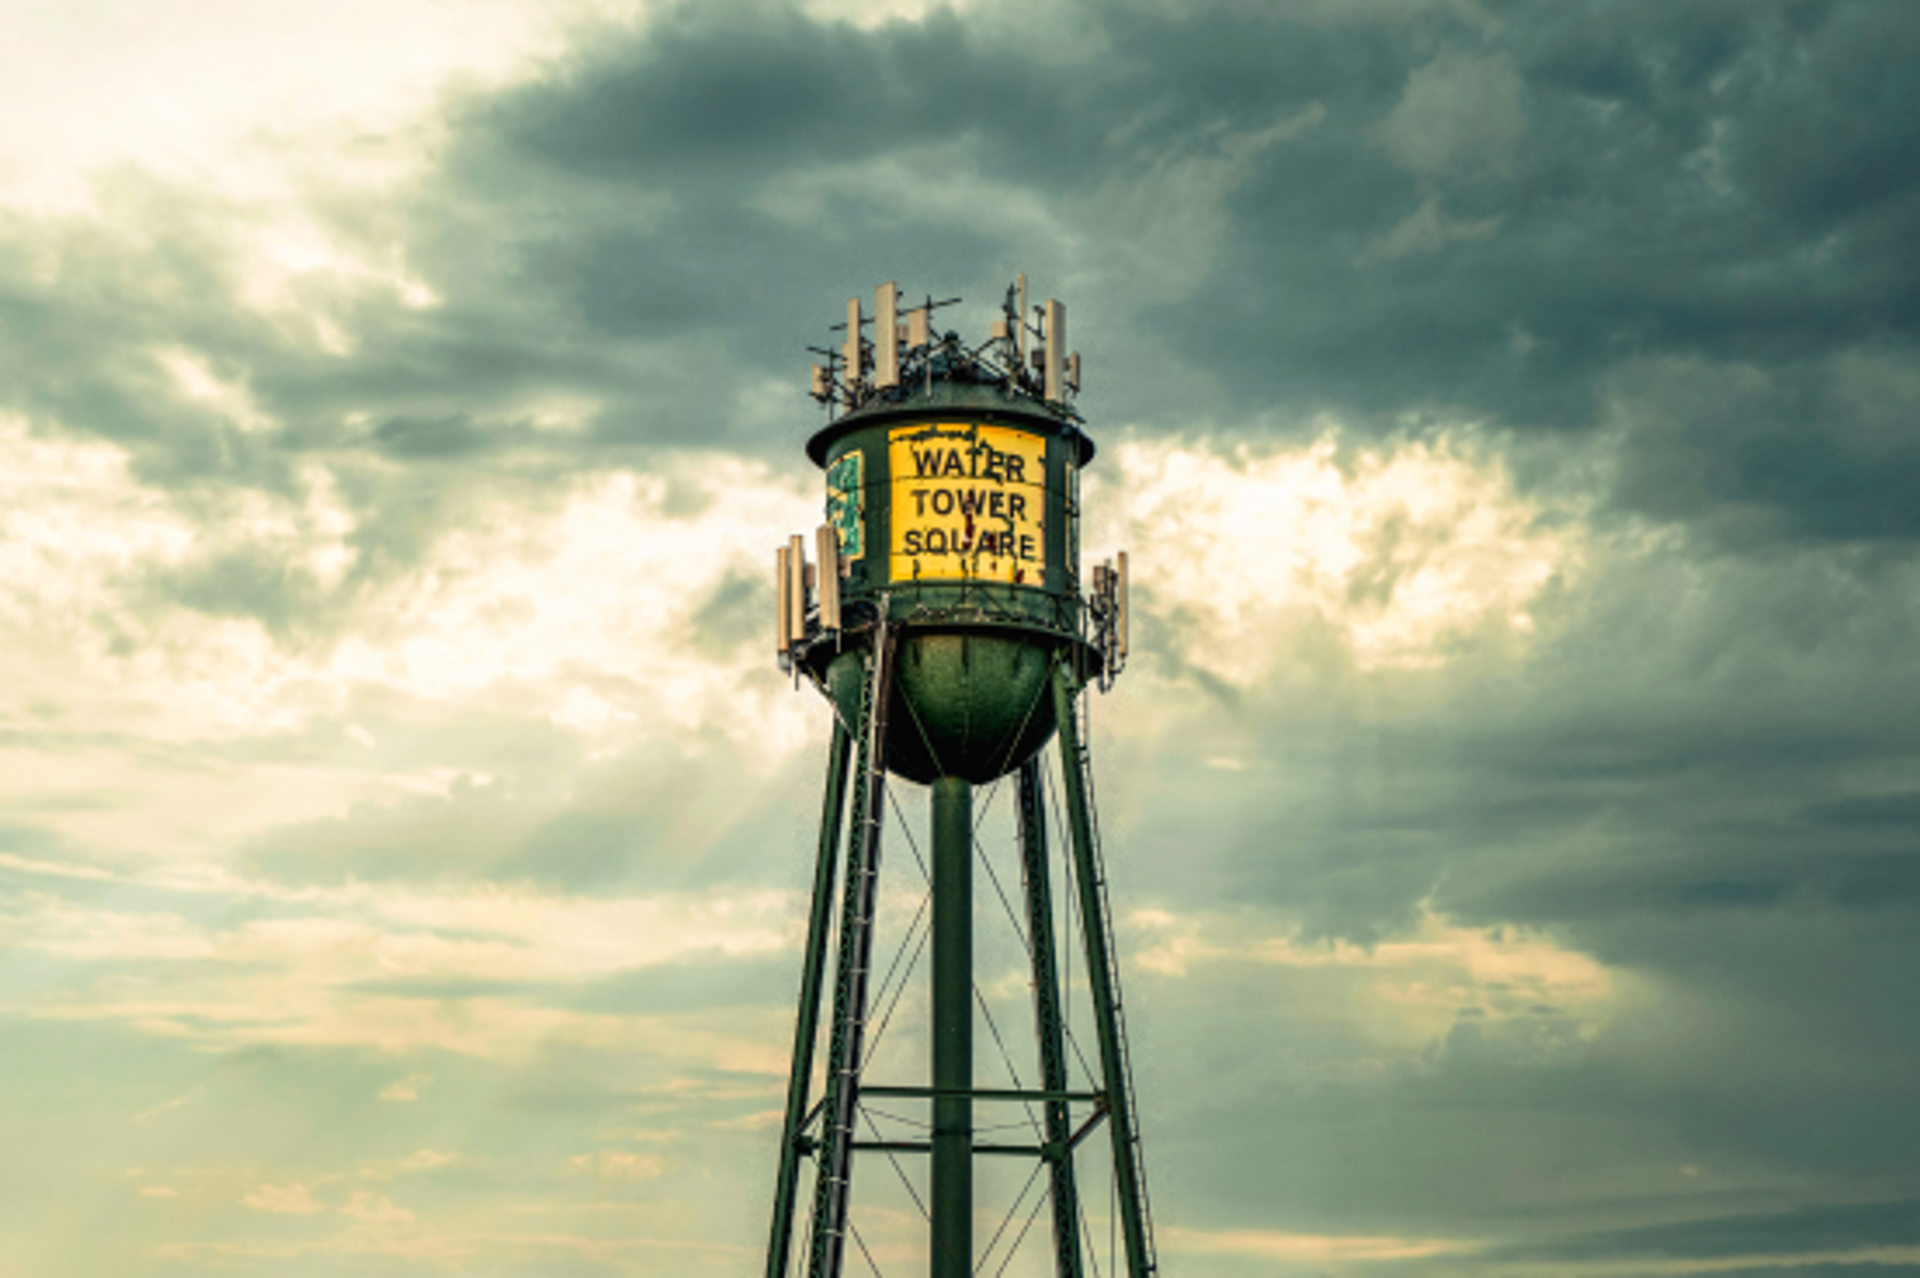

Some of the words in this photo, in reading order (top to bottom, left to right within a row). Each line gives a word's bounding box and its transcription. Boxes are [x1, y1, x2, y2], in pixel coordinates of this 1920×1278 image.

[913, 448, 1026, 483] WATER
[910, 488, 1026, 521] TOWER
[904, 528, 1036, 562] SQUARE
